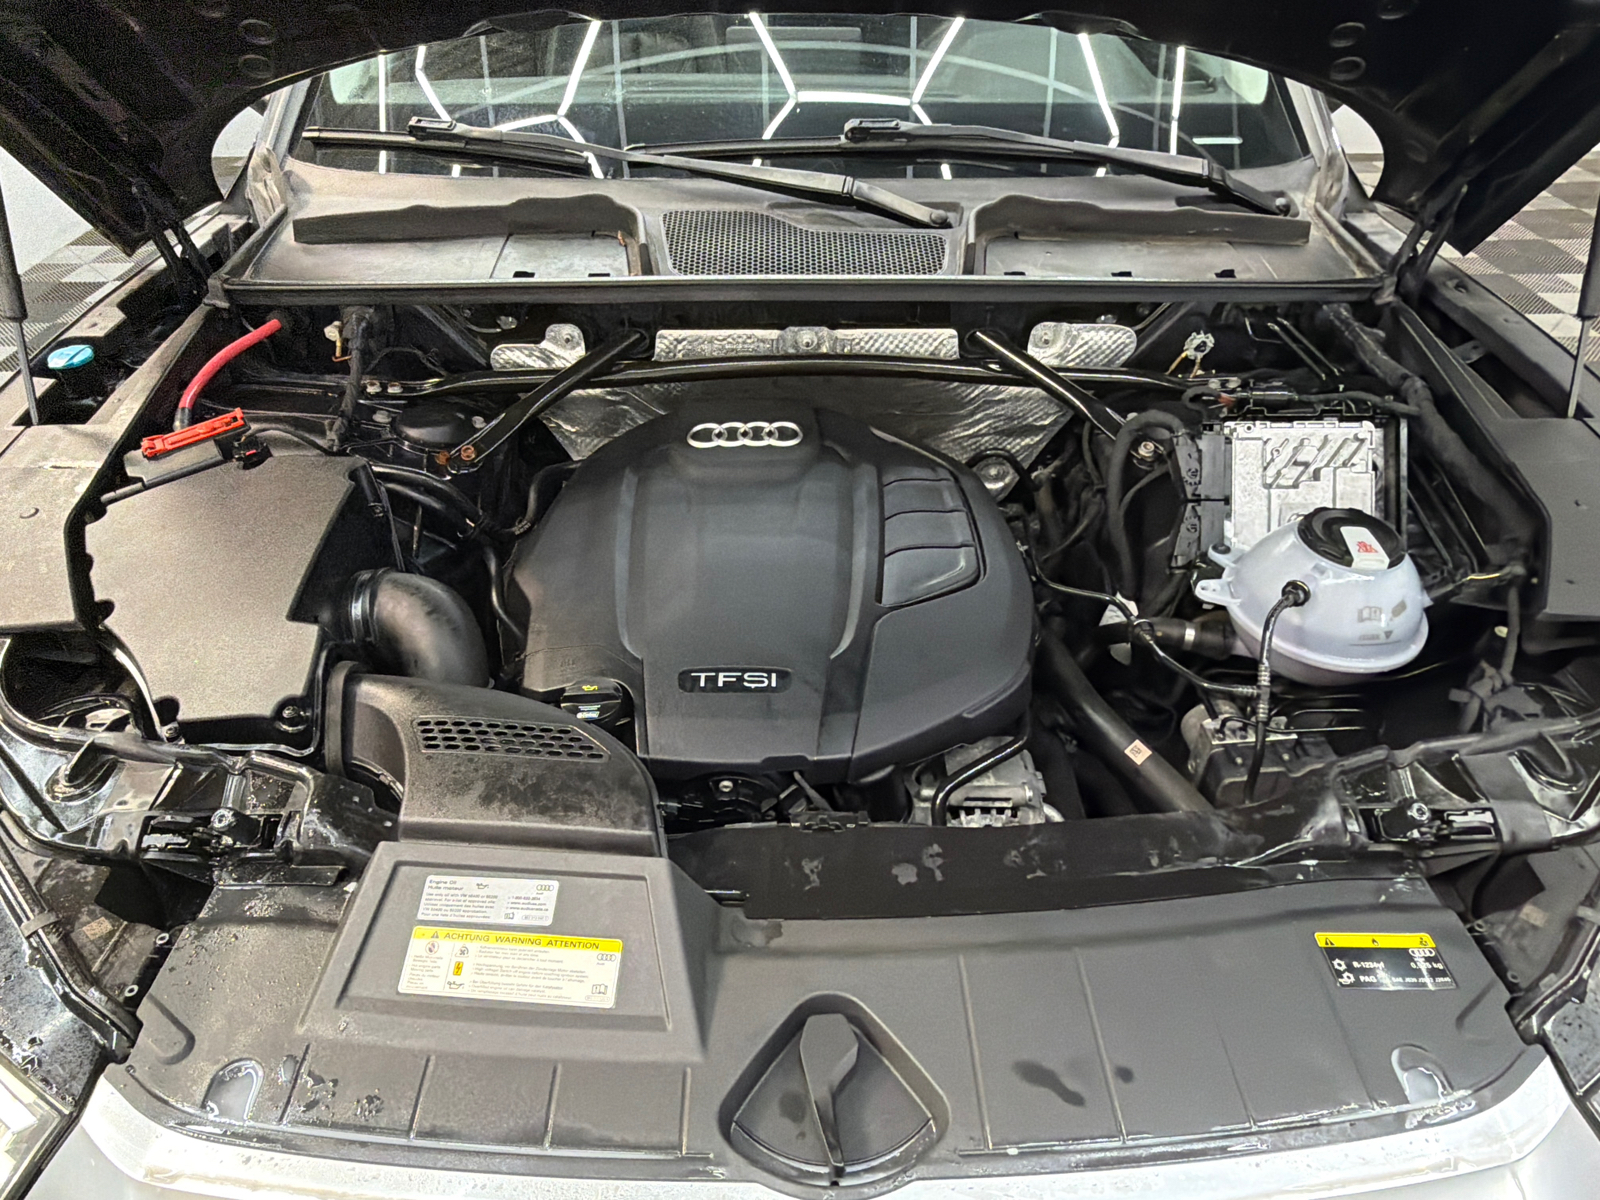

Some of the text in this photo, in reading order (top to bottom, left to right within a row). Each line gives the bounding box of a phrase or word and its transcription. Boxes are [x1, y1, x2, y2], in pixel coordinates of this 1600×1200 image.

[690, 672, 776, 688] TFSI
[444, 932, 490, 942] ACHTUNG
[495, 936, 542, 946] WARNING
[546, 940, 600, 949] ATTENTION
